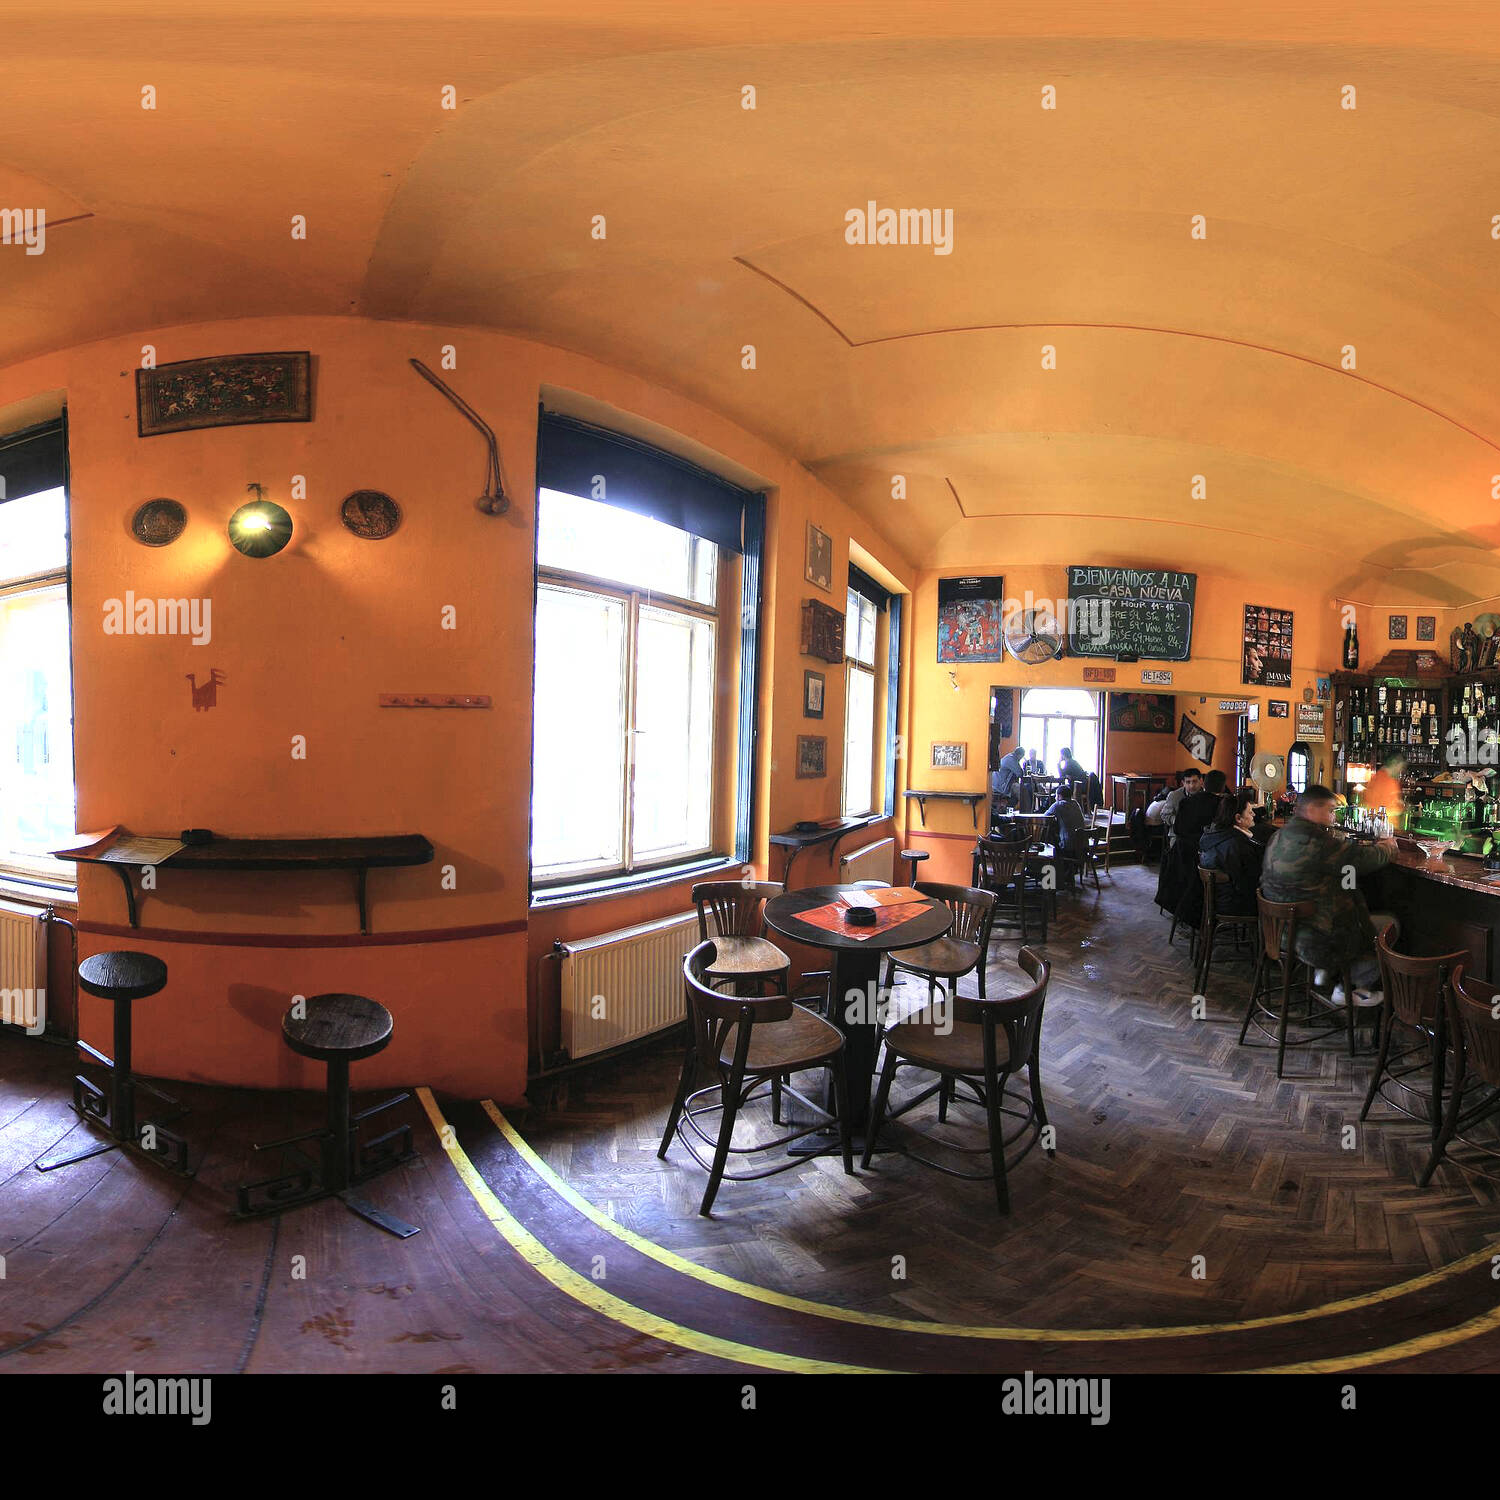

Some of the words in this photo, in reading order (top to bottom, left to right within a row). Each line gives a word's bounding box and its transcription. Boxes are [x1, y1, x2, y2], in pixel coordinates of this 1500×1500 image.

[1160, 573, 1169, 589] A
[1174, 574, 1190, 590] LA
[1099, 586, 1132, 598] CASA
[1121, 600, 1147, 609] HOUR
